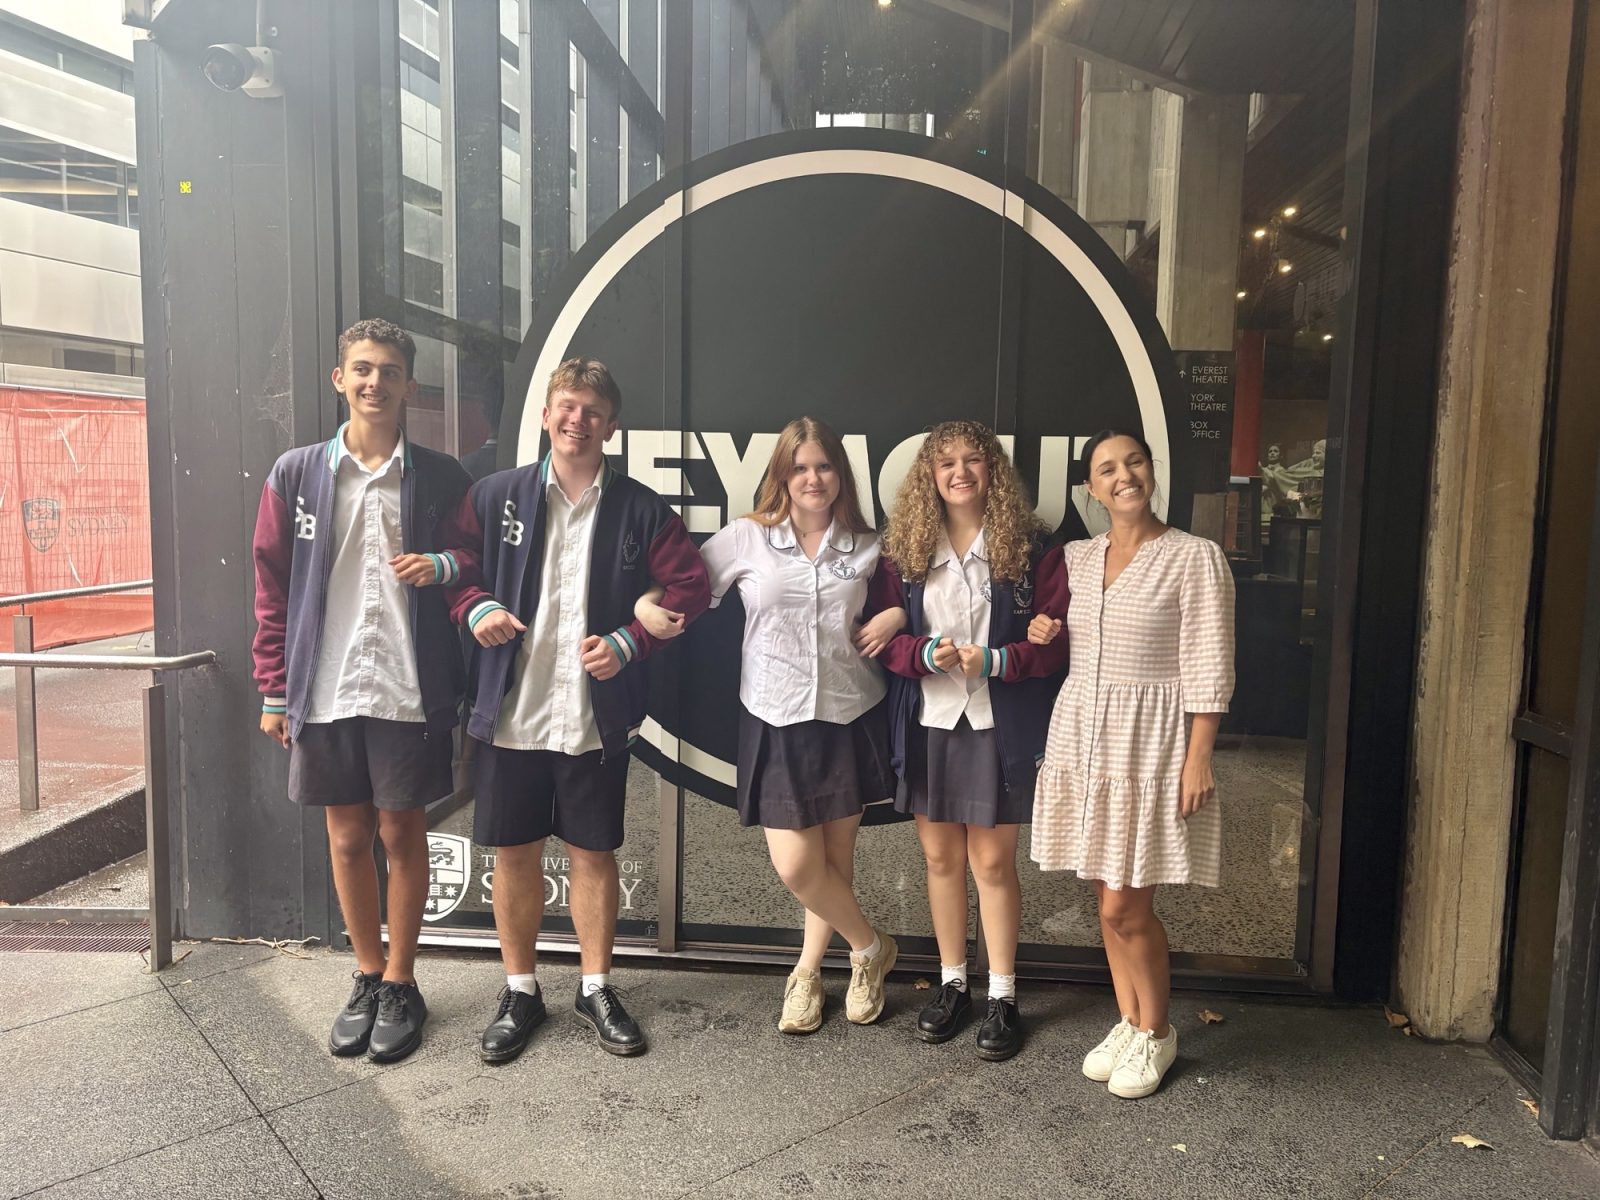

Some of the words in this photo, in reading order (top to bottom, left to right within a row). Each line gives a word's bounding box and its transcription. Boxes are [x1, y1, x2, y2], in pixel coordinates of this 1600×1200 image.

[1192, 366, 1228, 375] EVEREST
[1191, 375, 1228, 384] THEATRE
[1191, 393, 1215, 402] YORK
[1190, 402, 1227, 411] THEATRE
[1190, 420, 1208, 429] BOX
[603, 429, 1110, 546] EYOU
[621, 860, 643, 874] OF
[481, 871, 642, 910] SDY
